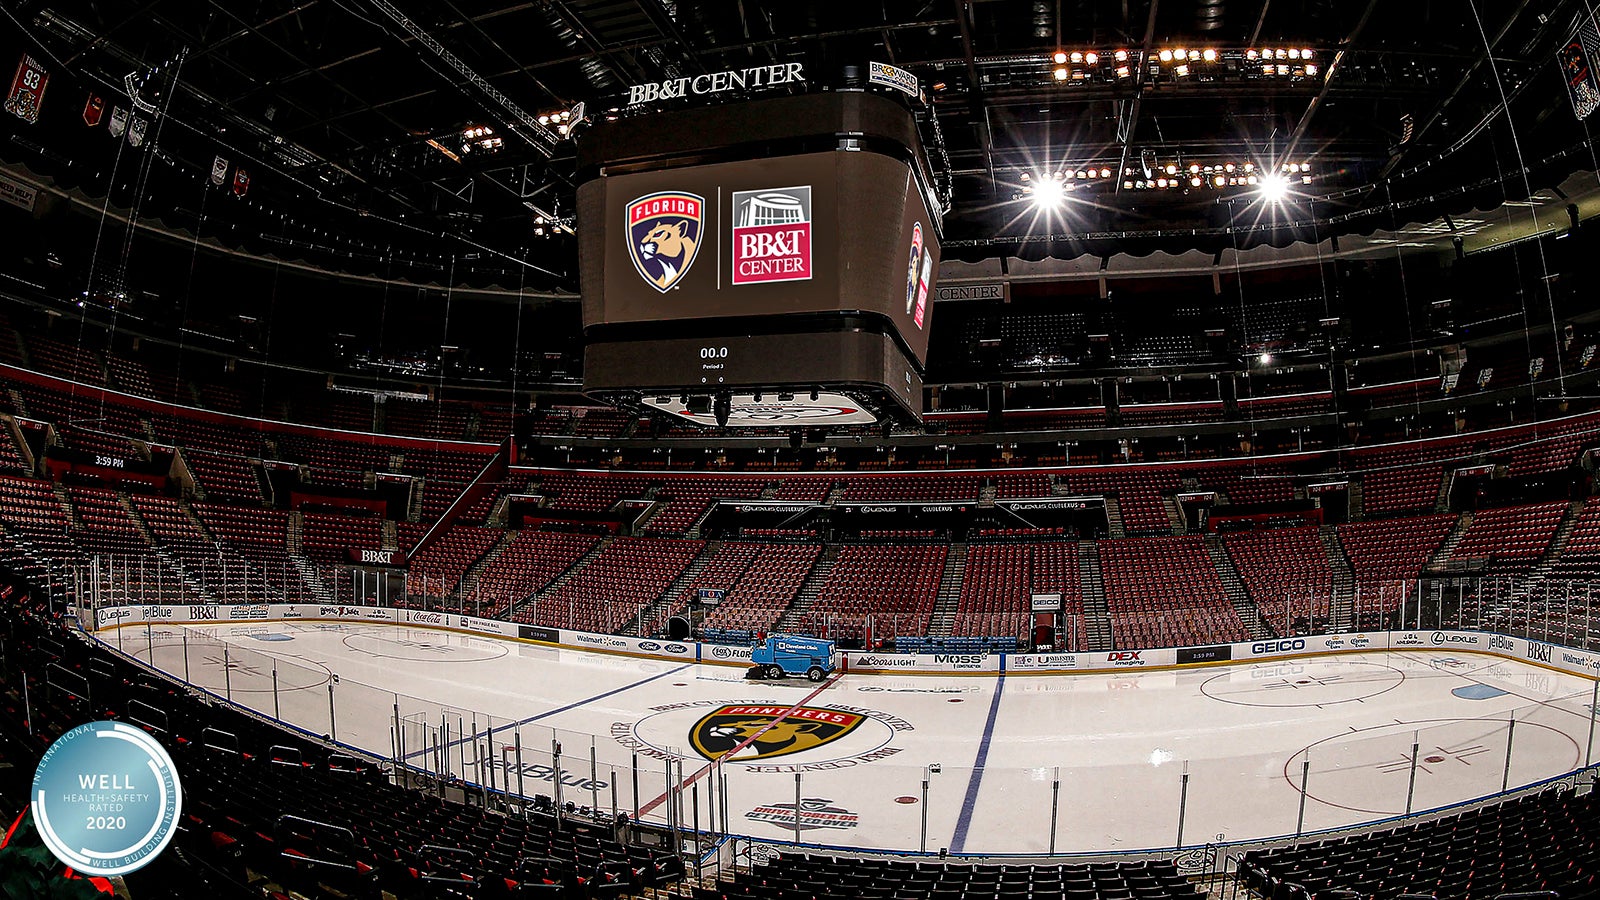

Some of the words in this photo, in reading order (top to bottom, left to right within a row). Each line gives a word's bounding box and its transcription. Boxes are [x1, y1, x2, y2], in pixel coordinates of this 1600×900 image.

[23, 69, 41, 90] 93
[872, 63, 917, 85] BROWARD
[628, 76, 692, 105] BB&T
[692, 62, 805, 94] CENTER
[636, 200, 695, 219] FLORIDA
[740, 230, 805, 259] BB&T
[739, 257, 805, 276] CENTER
[940, 286, 1000, 300] CENTER
[700, 347, 728, 359] 00.0
[95, 455, 112, 467] 3:59
[112, 458, 124, 468] PM
[361, 550, 394, 564] BB&T
[142, 606, 172, 620] jetBlue
[189, 606, 219, 620] BB&T
[576, 634, 602, 644] Walmart
[1325, 639, 1345, 647] Corona
[1445, 635, 1478, 644] LEXUS
[1488, 634, 1514, 651] jetBlue
[639, 642, 661, 651] Ford
[664, 644, 687, 653] Ford
[1252, 639, 1306, 654] GEICO
[1527, 641, 1554, 663] BB&T
[732, 650, 751, 658] FLOR
[867, 655, 893, 665] Coors
[934, 655, 981, 663] MOSS
[1107, 651, 1142, 661] DEX
[1562, 653, 1585, 666] Walmart
[728, 705, 846, 723] PANTHERS
[744, 811, 771, 819] GET
[822, 819, 859, 828] OVER
[753, 806, 792, 816] DRIVE
[839, 813, 859, 821] OR
